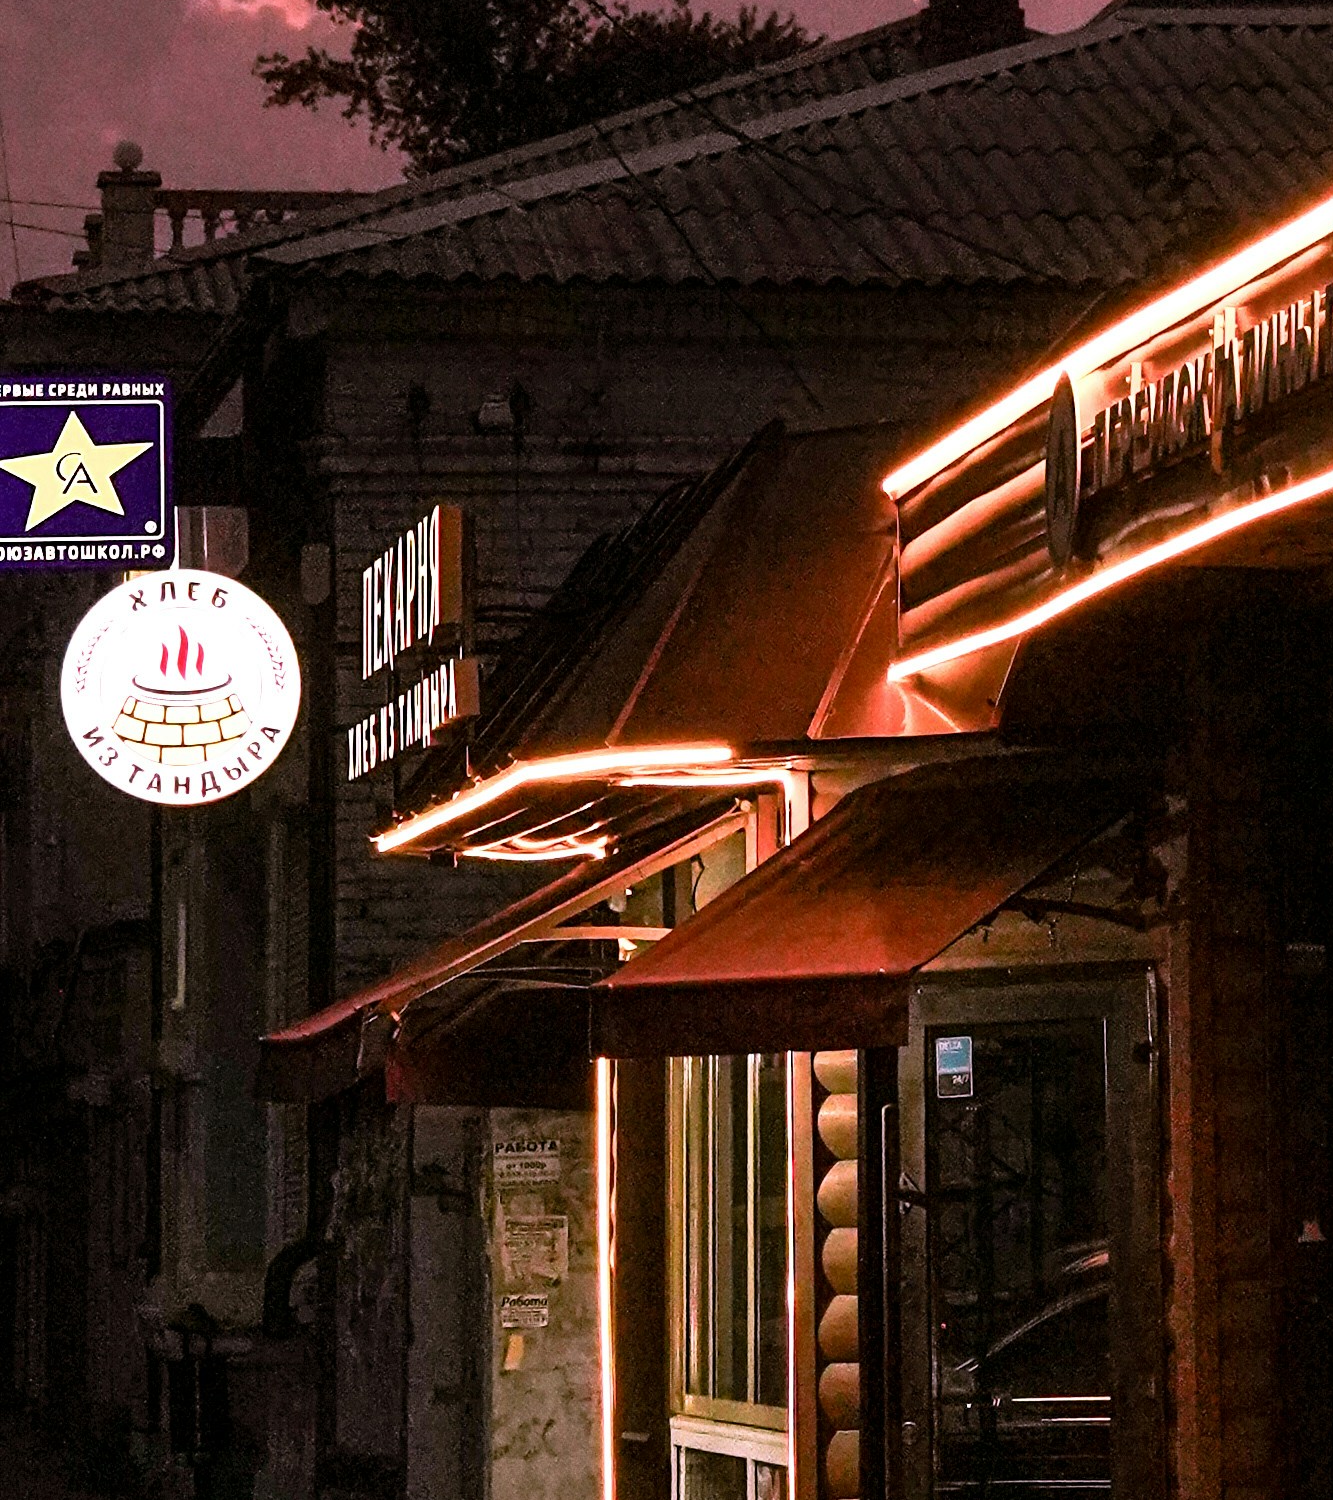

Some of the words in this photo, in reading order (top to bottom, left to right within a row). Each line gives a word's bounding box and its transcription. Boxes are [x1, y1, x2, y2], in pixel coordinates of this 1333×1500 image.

[0, 384, 43, 397] РВЫЕ
[48, 383, 98, 398] СРЕДИ
[103, 383, 164, 396] РАВНЫХ
[128, 581, 228, 611] ХЛЕБ
[362, 504, 440, 681] ПЕКАРНЯ
[348, 713, 377, 781] ХЛЕБ
[380, 701, 395, 761] ИЗ
[398, 658, 458, 749] ТАНДЫРА
[83, 726, 118, 766] ИЗ
[128, 726, 281, 798] ТАНДЫРА
[495, 1140, 557, 1153] РАБОТА
[501, 1296, 548, 1307] Работа
